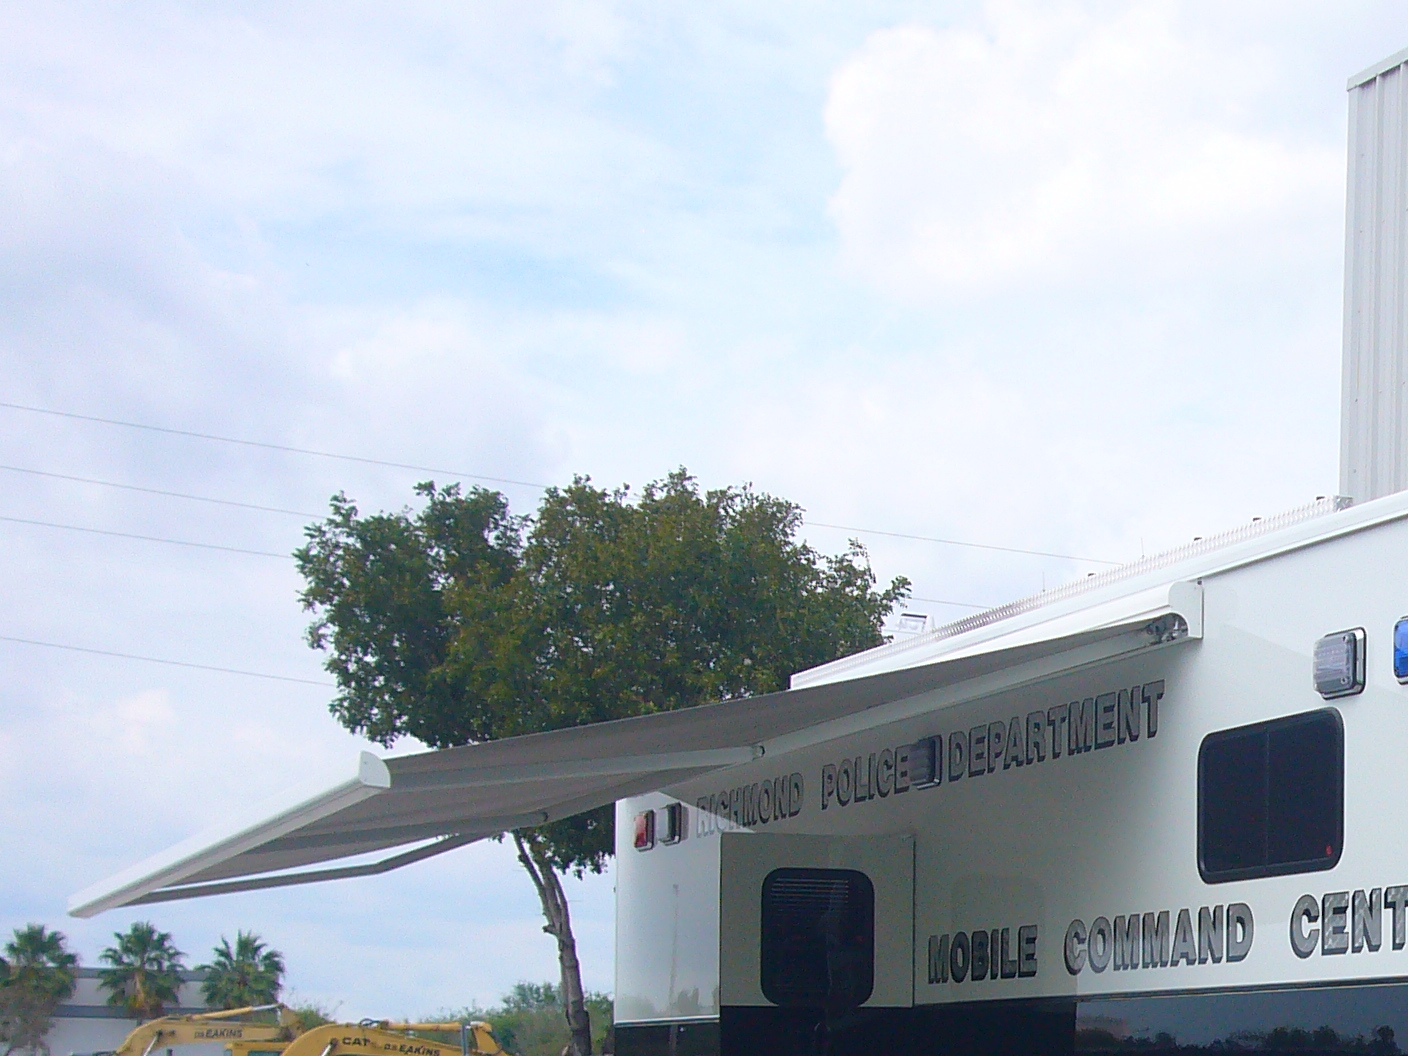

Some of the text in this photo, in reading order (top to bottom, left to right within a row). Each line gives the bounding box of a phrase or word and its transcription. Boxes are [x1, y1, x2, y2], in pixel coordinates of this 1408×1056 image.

[696, 679, 1166, 838] RICHMOND POLICE DEPARTMENT
[927, 924, 1038, 985] MOBILE
[1063, 901, 1255, 976] COMMAND
[342, 1036, 371, 1047] CAT
